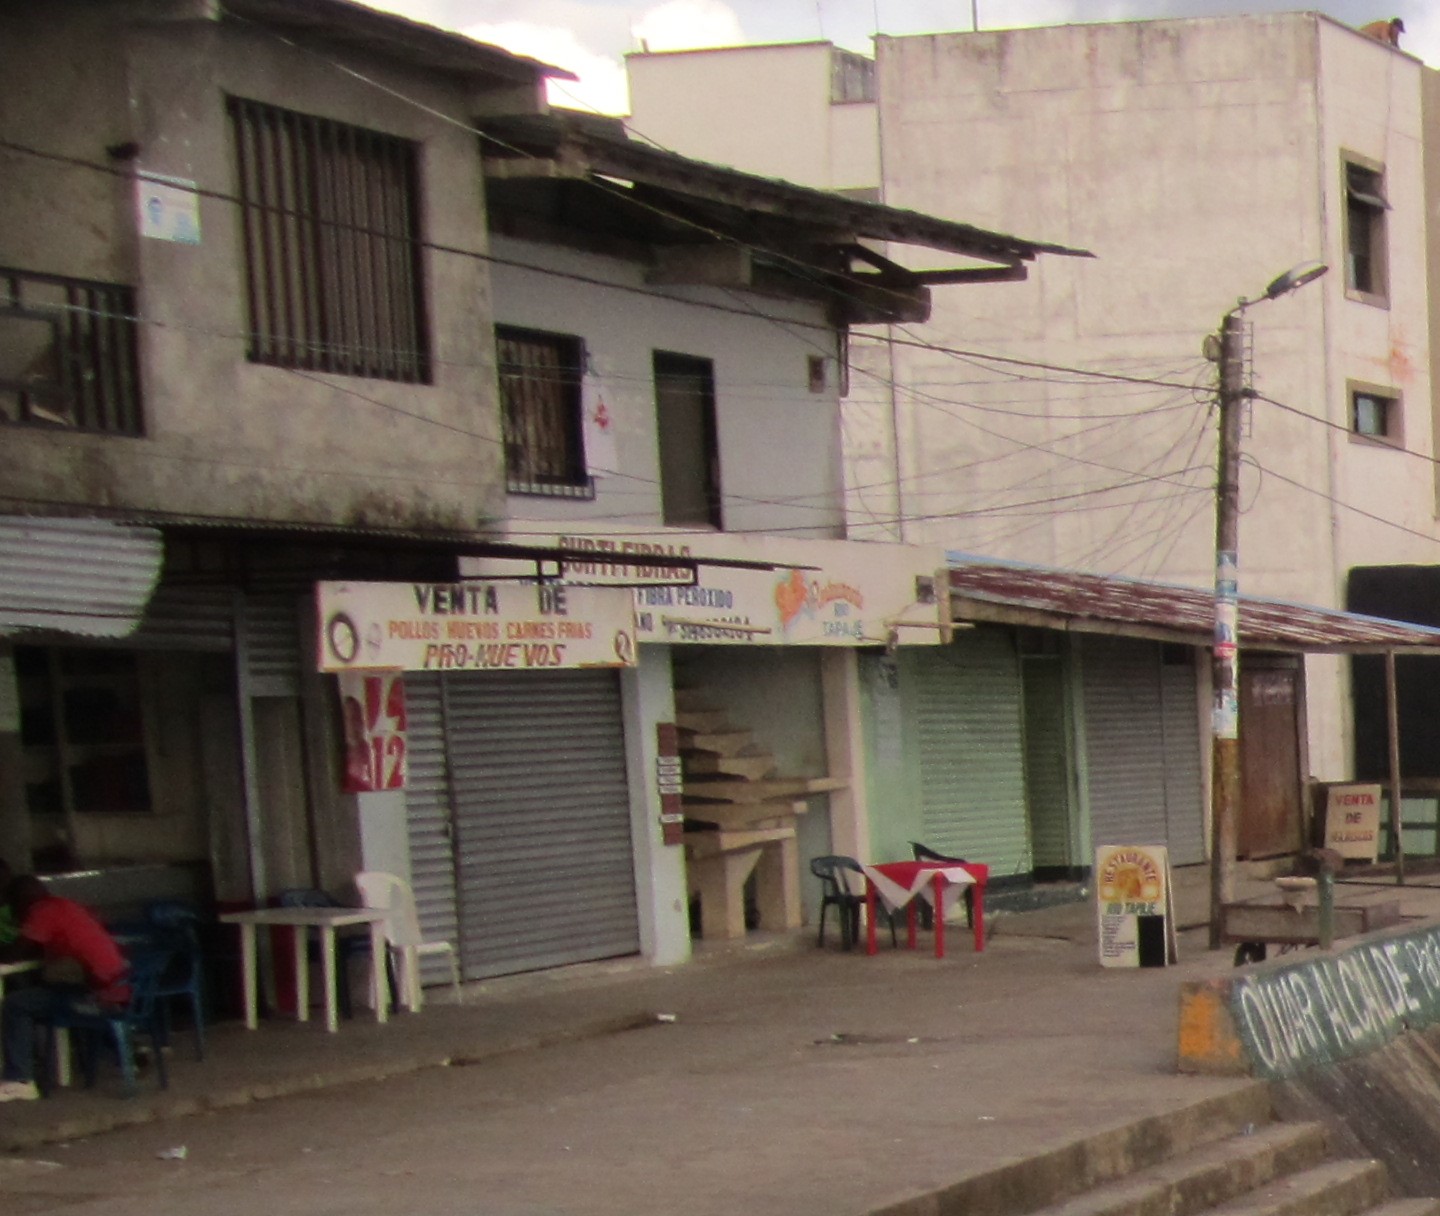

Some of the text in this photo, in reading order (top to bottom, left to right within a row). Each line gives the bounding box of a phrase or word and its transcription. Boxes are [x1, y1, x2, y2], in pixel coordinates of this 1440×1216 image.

[413, 584, 568, 615] VENTA DE
[676, 588, 734, 609] PEROXIDO
[388, 621, 440, 640] POLLOS
[506, 621, 557, 640] CARNES
[557, 622, 592, 640] FRIAS
[1334, 793, 1375, 807] VENTA
[1345, 811, 1362, 825] DE
[1309, 943, 1421, 1048] ALCALDE
